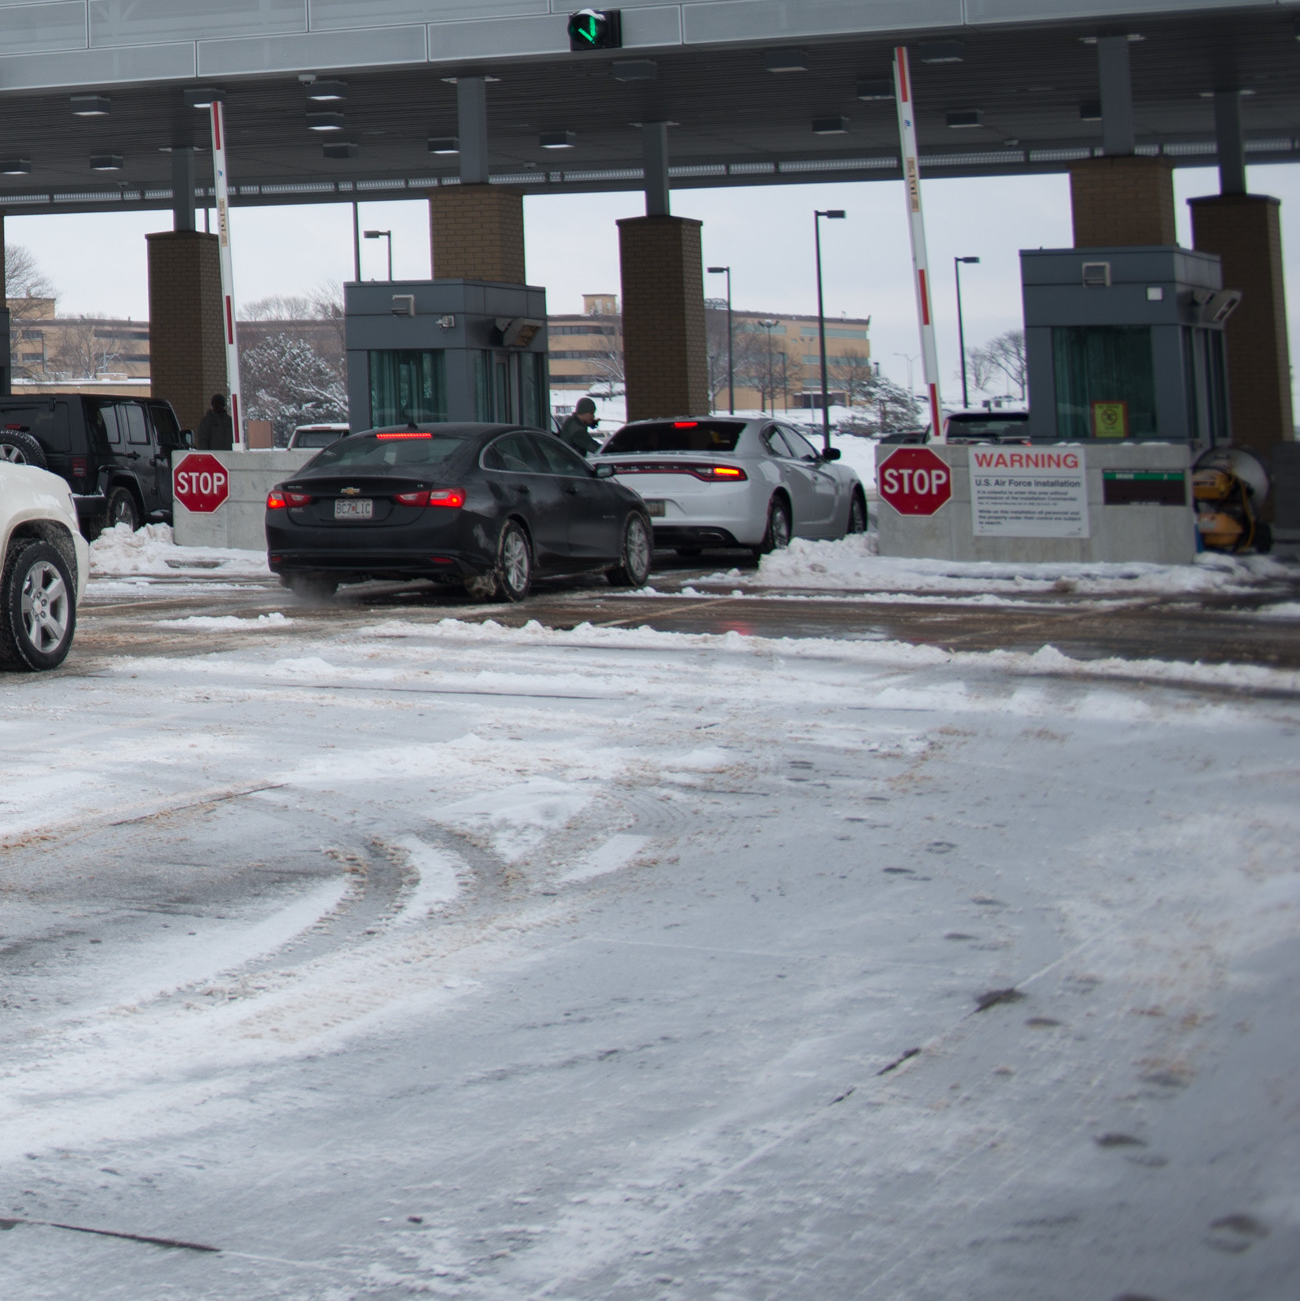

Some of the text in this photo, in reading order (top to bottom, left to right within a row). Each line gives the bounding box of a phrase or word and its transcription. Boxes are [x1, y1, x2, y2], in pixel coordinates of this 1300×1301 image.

[974, 453, 1079, 469] WARNING
[177, 471, 225, 494] STOP
[883, 468, 947, 495] STOP
[975, 479, 1081, 488] U.S. Air Force Installation
